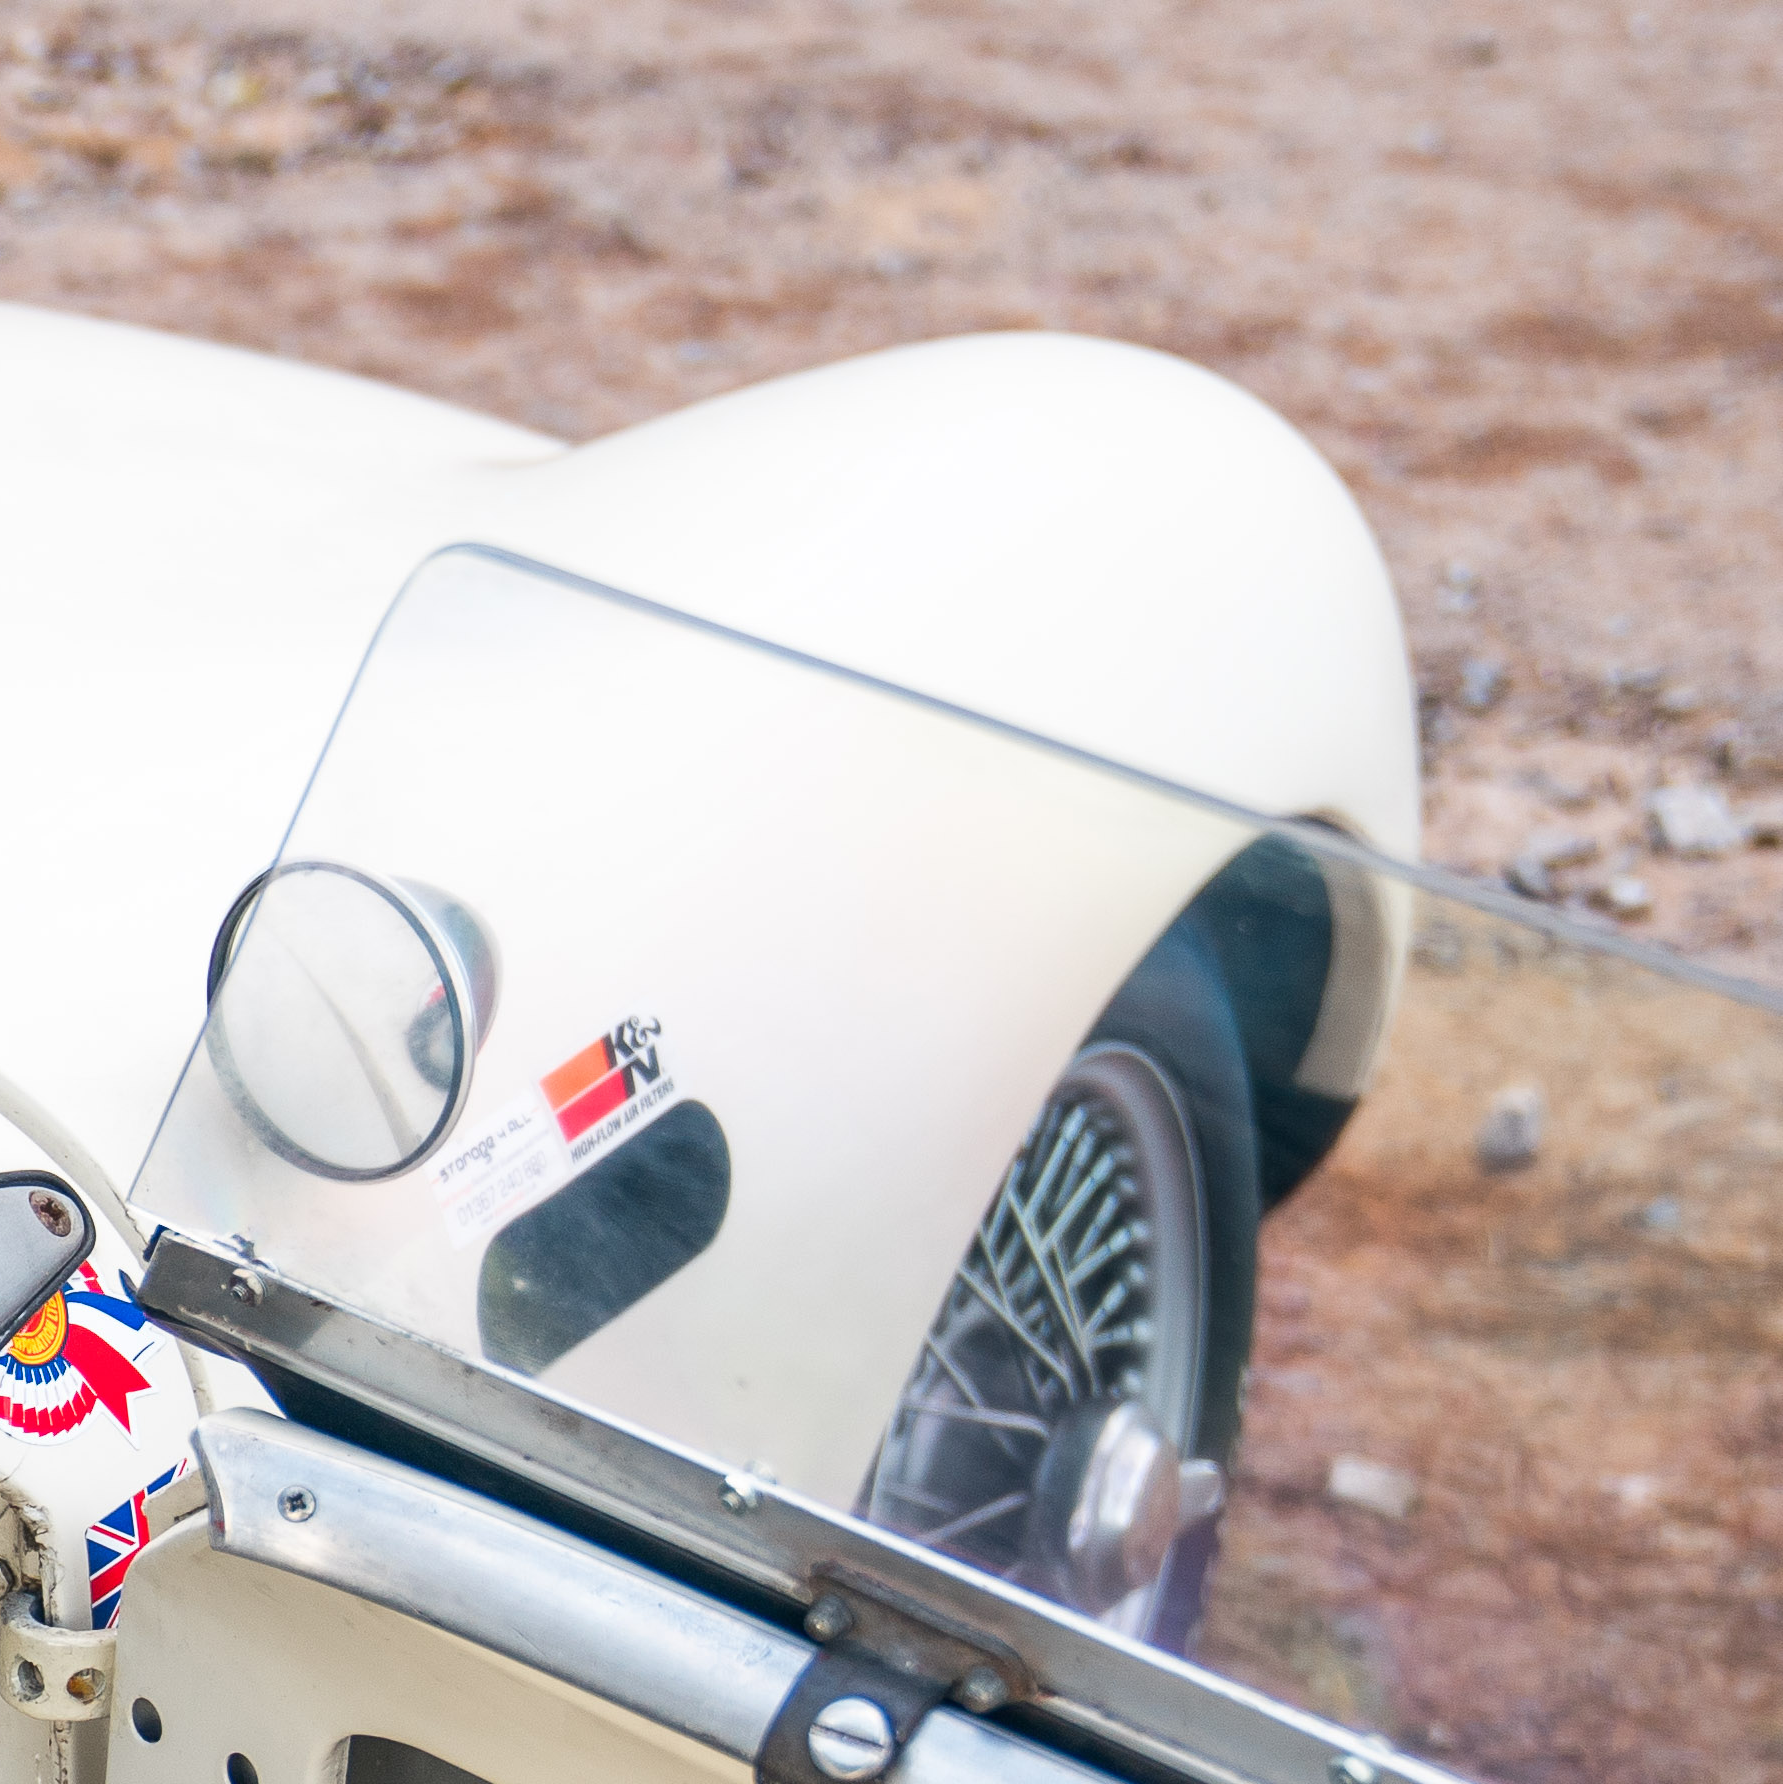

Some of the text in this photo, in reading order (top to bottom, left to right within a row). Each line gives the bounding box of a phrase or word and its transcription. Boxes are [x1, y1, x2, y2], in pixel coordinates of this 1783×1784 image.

[569, 1116, 623, 1164] HIGH-FLOW
[623, 1103, 641, 1130] AIR
[639, 1077, 676, 1114] FILTERS
